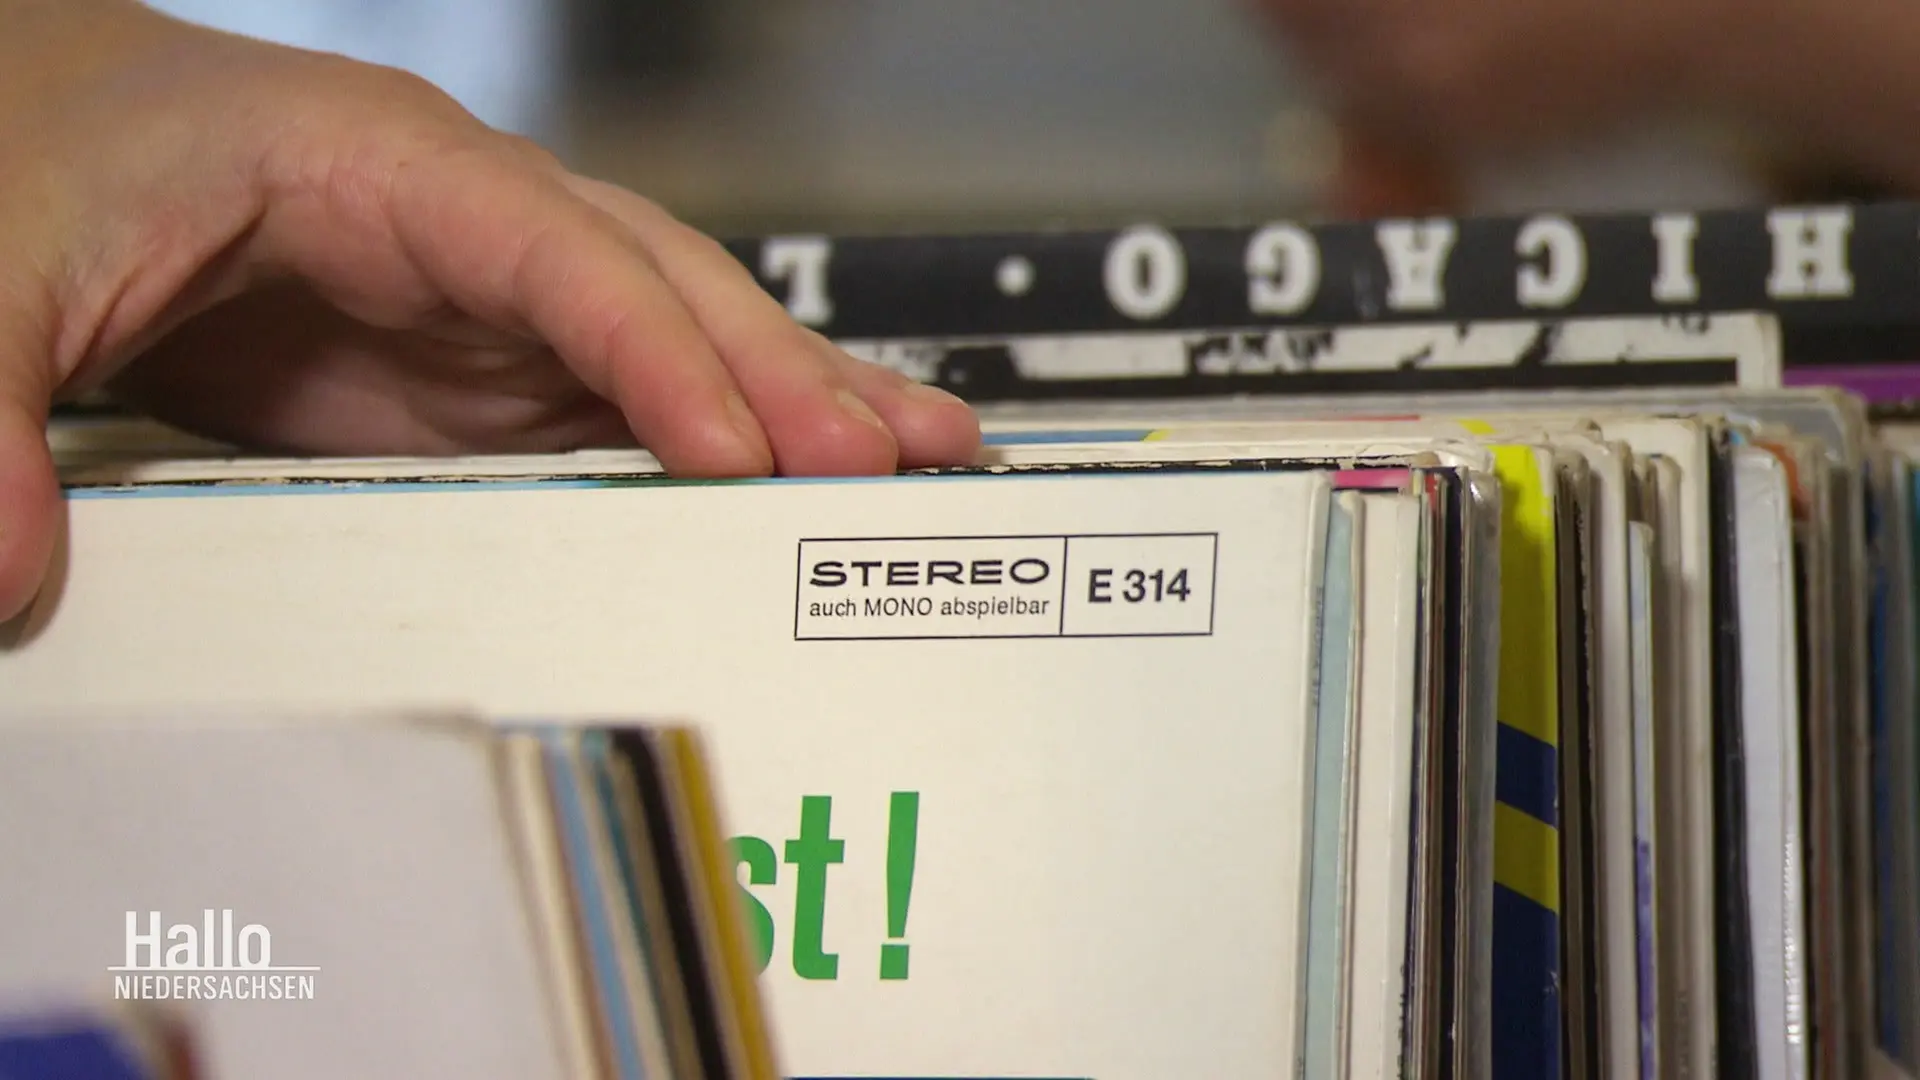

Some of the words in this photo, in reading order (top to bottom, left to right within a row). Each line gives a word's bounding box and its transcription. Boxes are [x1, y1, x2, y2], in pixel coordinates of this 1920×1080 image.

[809, 558, 1050, 587] STEREO
[1088, 568, 1113, 603] E
[1122, 568, 1191, 603] 314
[809, 598, 857, 617] auch
[864, 597, 933, 617] MONO
[940, 596, 1050, 620] abspielbar
